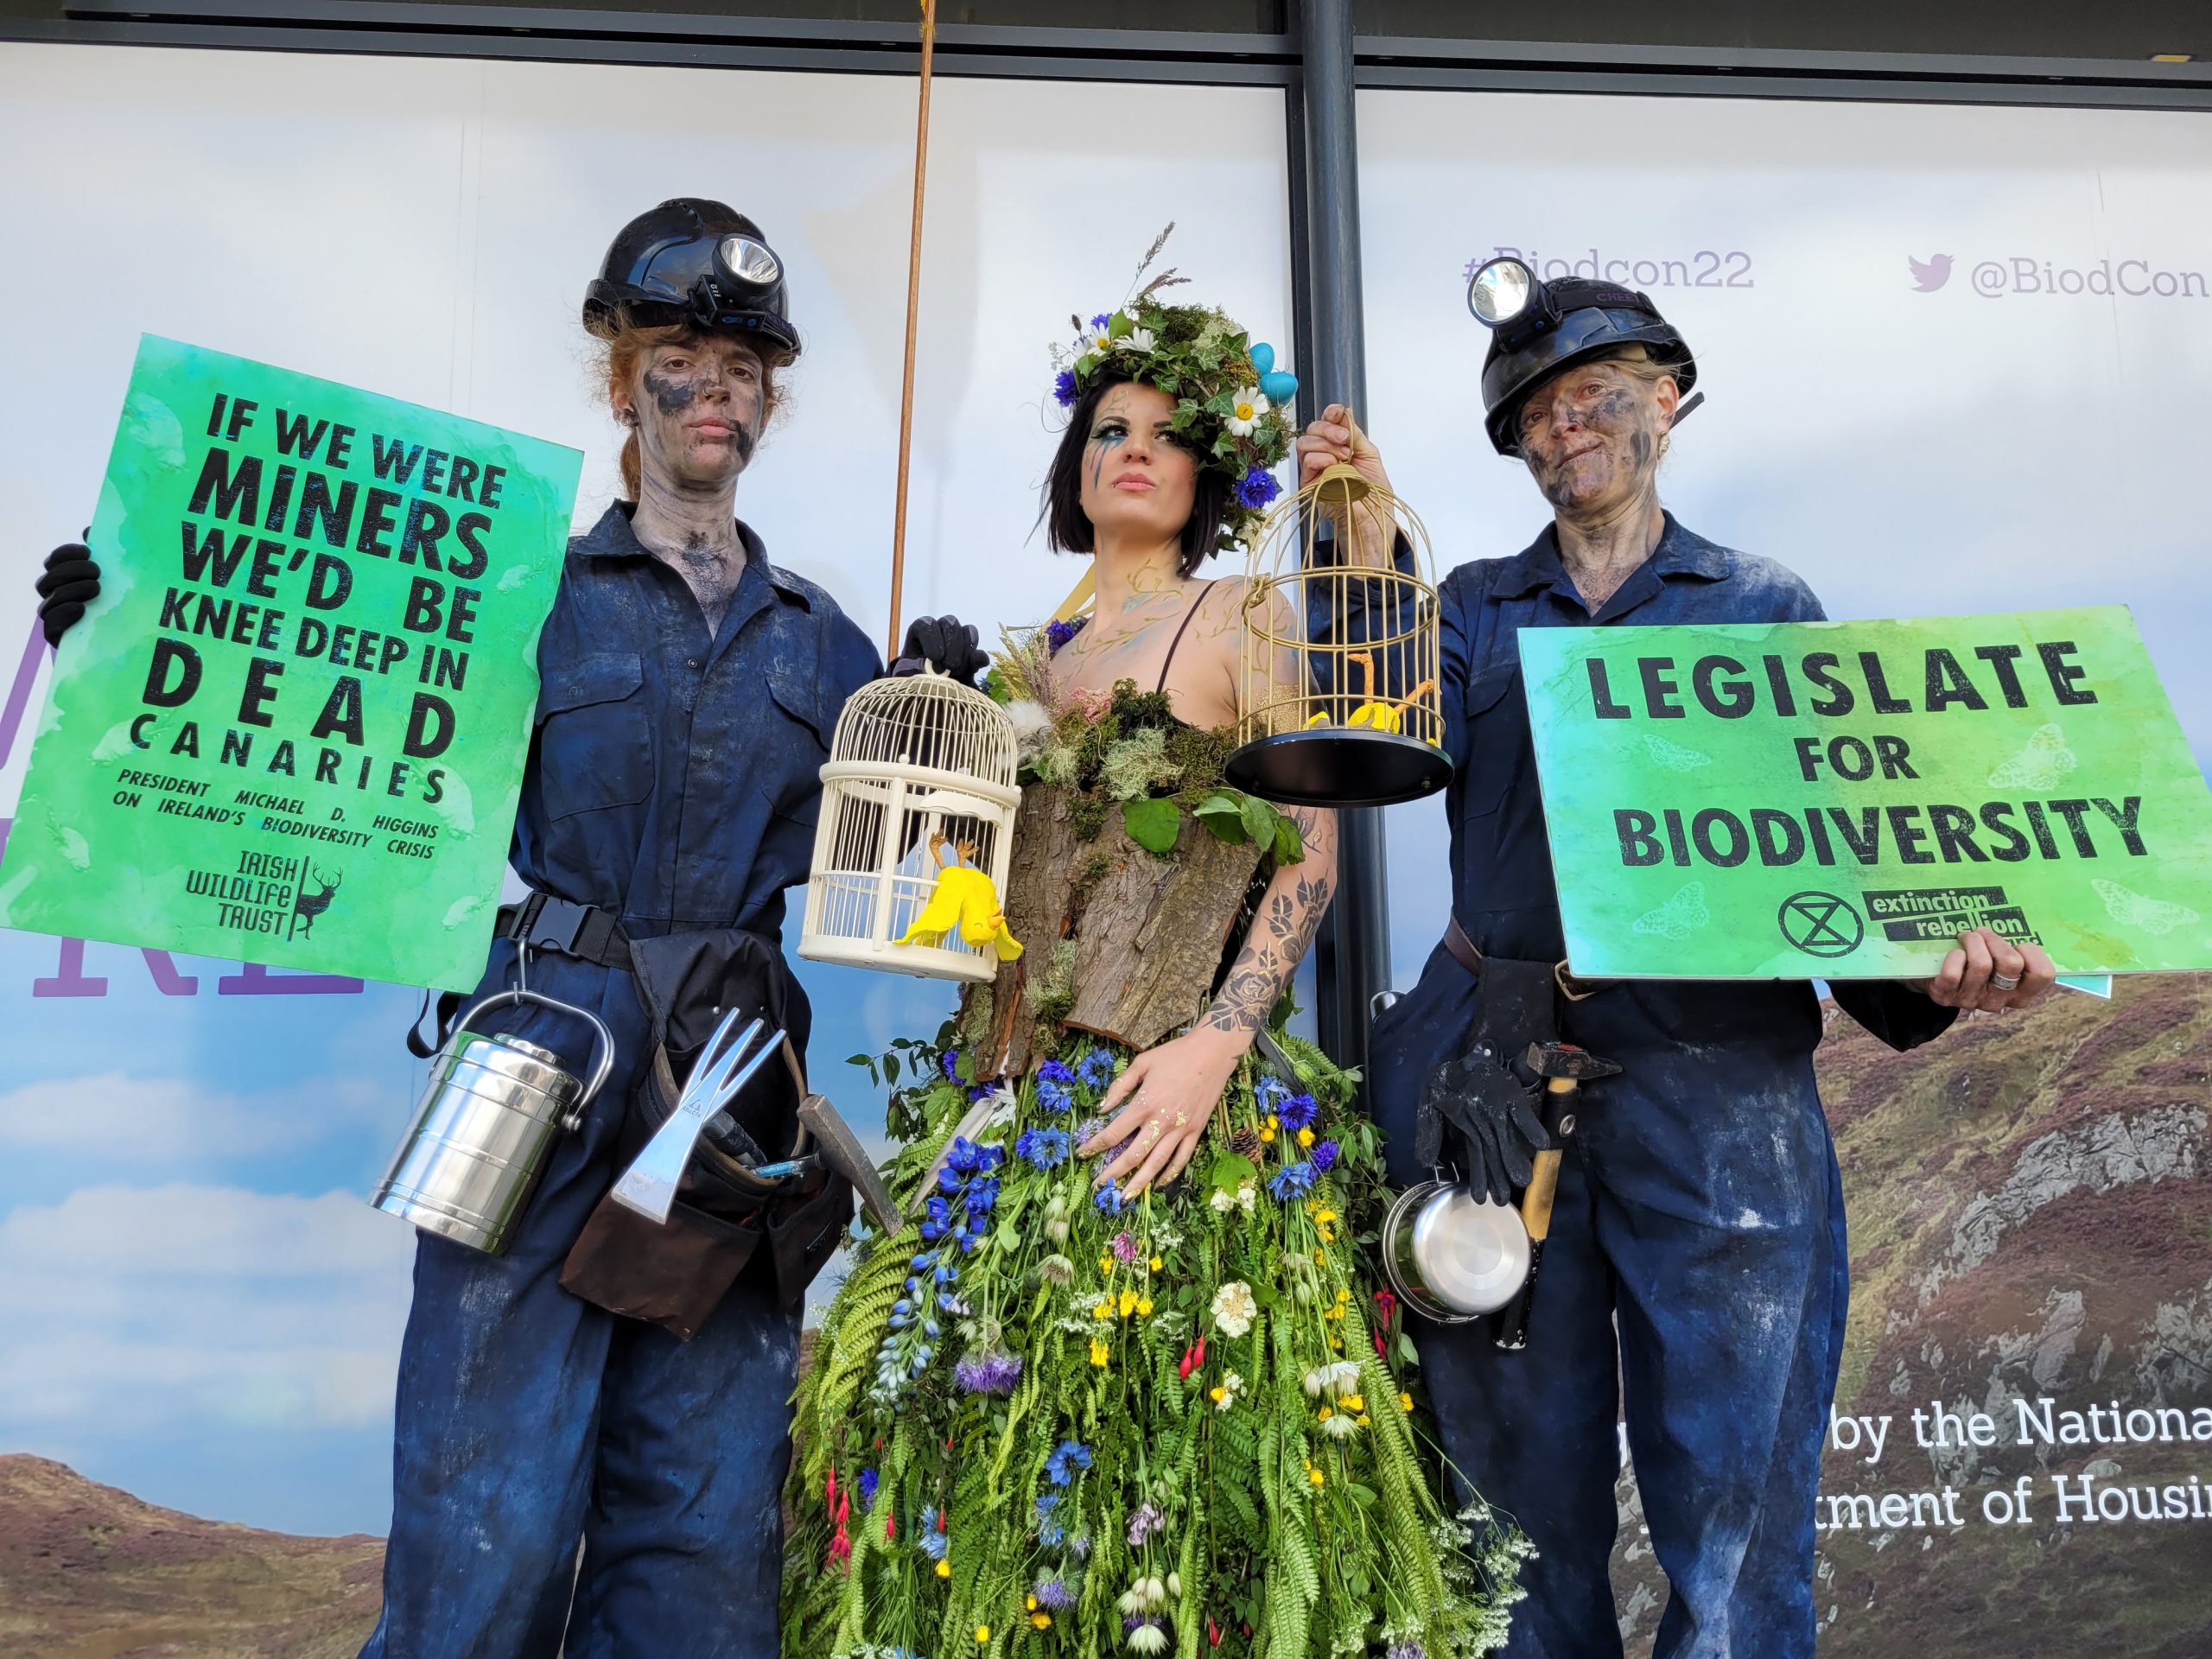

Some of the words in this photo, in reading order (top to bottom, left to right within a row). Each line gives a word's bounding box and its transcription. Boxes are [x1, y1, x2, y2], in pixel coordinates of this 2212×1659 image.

[1972, 257, 2210, 299] @BiodCon
[207, 392, 257, 442] IF
[276, 408, 356, 468] WE
[371, 433, 507, 509] WERE
[188, 448, 493, 580] MINERS
[181, 520, 353, 611] WE'D
[404, 575, 481, 643] BE
[159, 587, 286, 651] KNEE
[295, 617, 410, 674] DEEP
[420, 645, 469, 691] IN
[142, 637, 457, 760] DEAD
[1585, 639, 2099, 720] LEGISLATE
[130, 713, 445, 804] CANARIES
[1793, 734, 1921, 783] FOR
[113, 790, 143, 809] ON
[157, 798, 246, 827] IRELAND'S
[261, 816, 374, 849] BIODIVERSITY
[387, 839, 435, 860] CRISIS
[118, 768, 212, 798] PRESIDENT
[234, 789, 306, 816] MICHAEL
[330, 807, 346, 823] D.
[372, 814, 440, 839] HIGGINS
[1612, 795, 2149, 868] BIODIVERSITY
[237, 849, 300, 882] IRISH
[218, 902, 289, 936] TRUST
[1872, 890, 1988, 913] extinction
[1830, 1402, 1893, 1464] by
[1910, 1400, 1996, 1448] the
[1983, 1475, 2033, 1524] of
[2050, 1473, 2212, 1522] Housi
